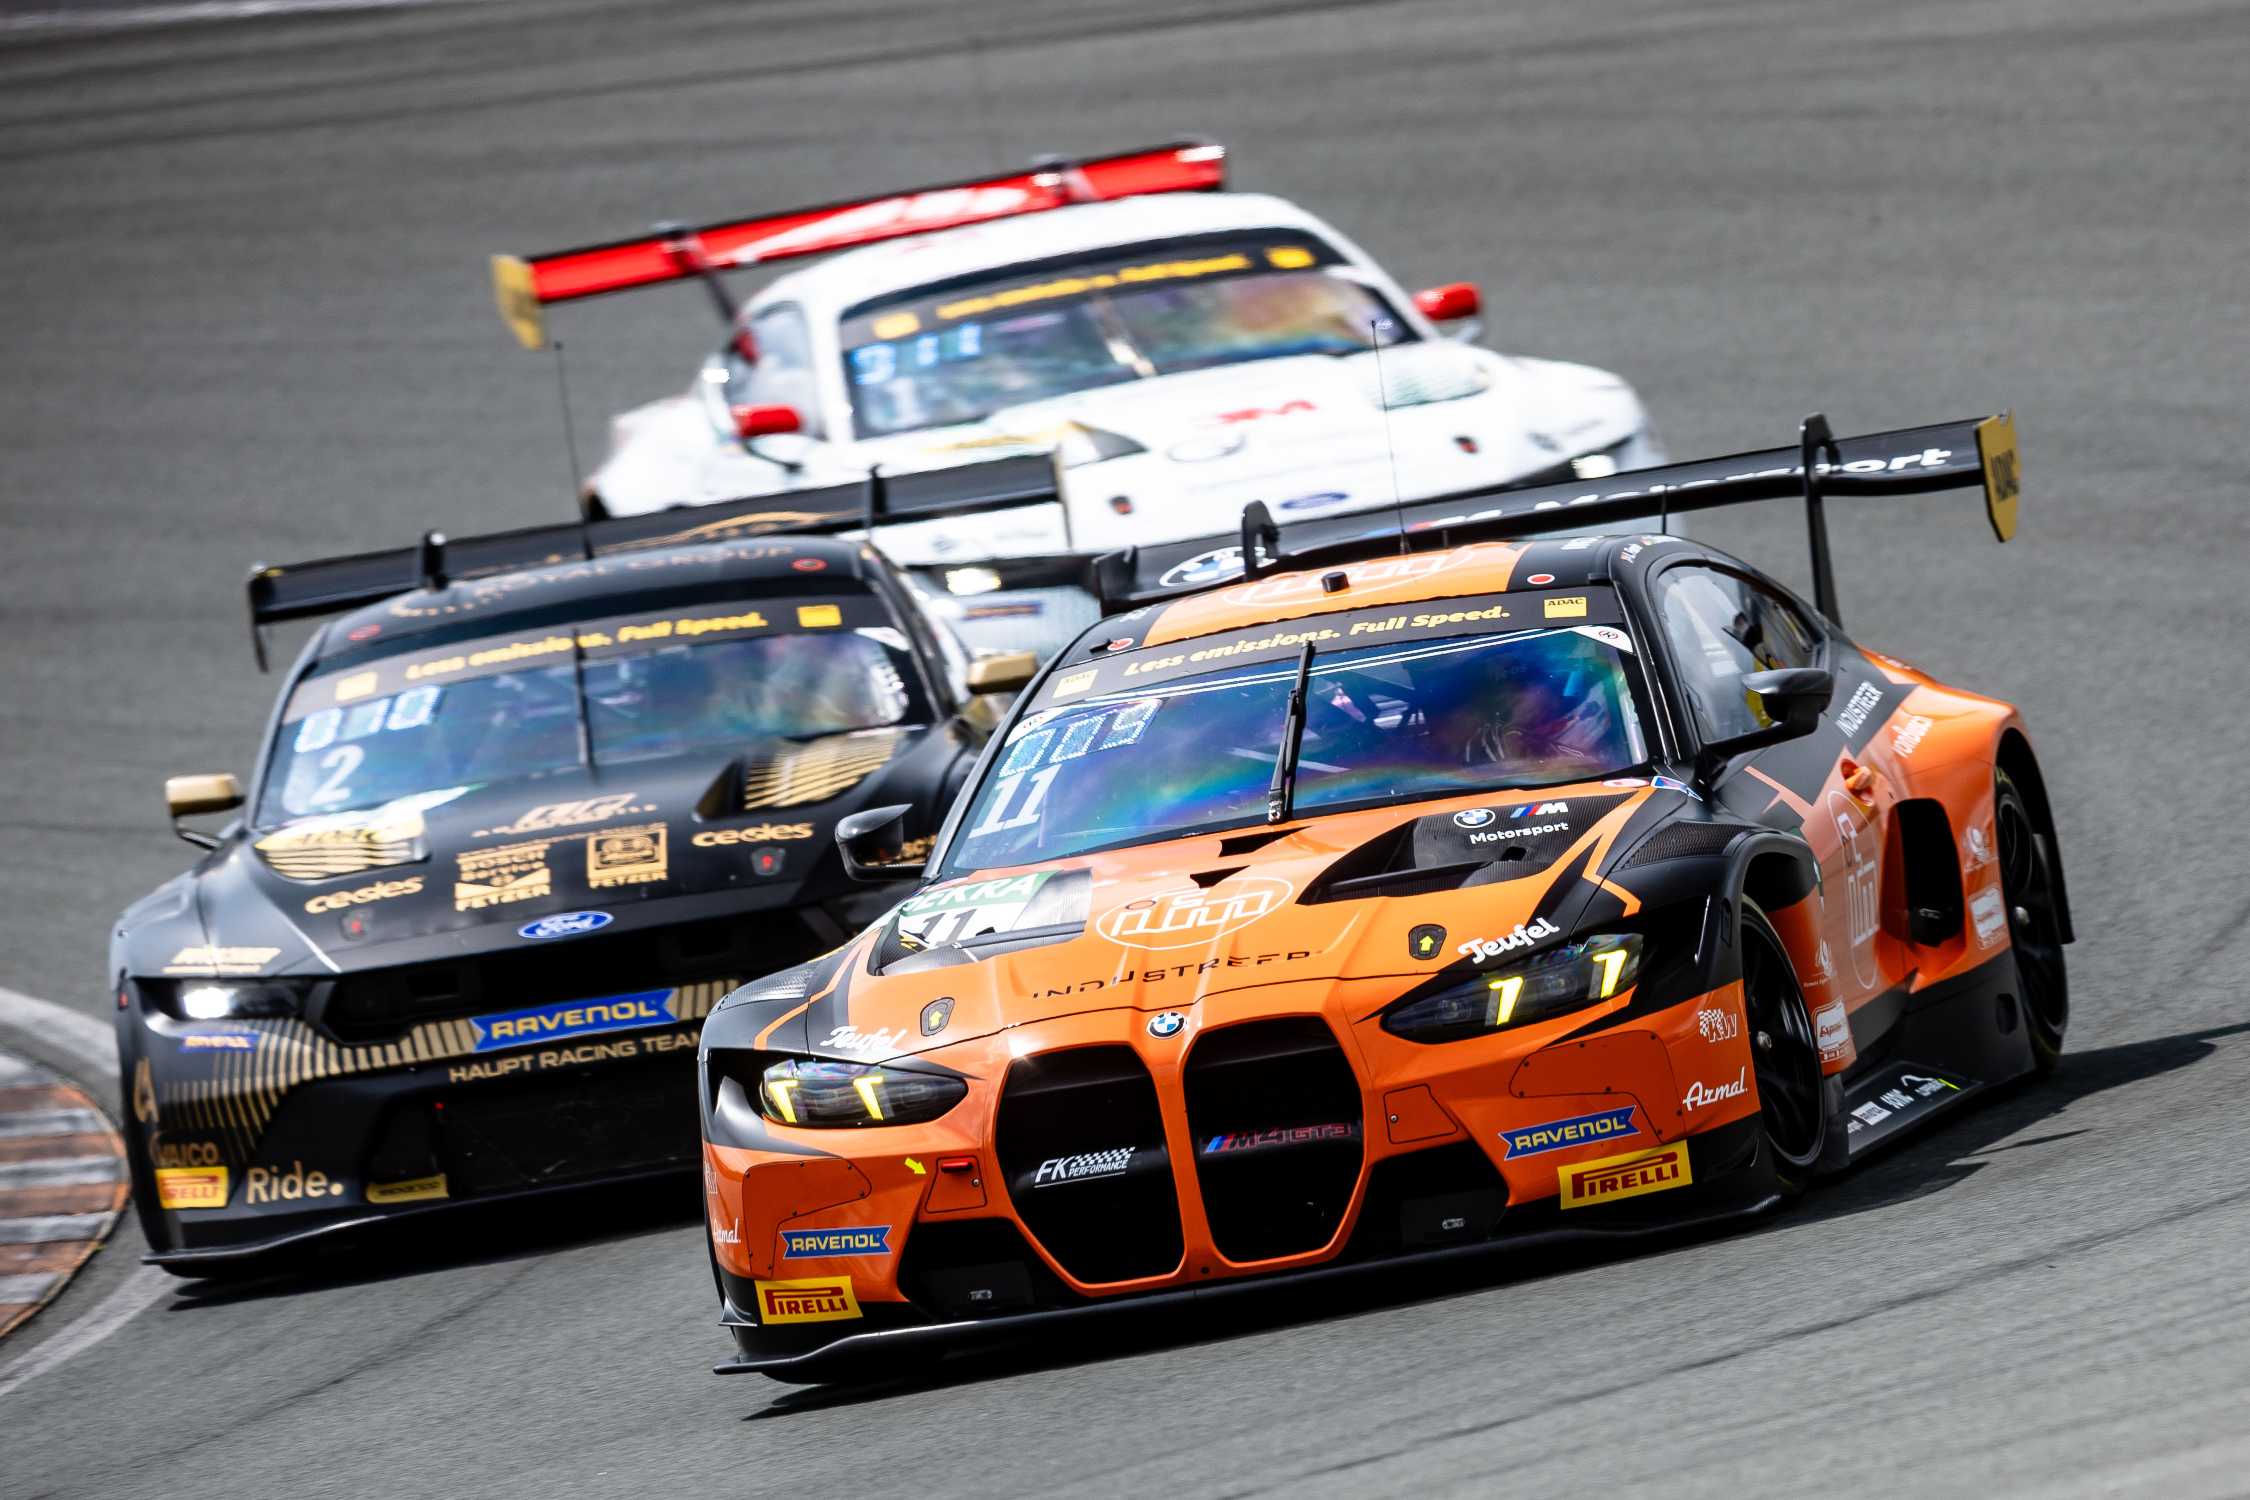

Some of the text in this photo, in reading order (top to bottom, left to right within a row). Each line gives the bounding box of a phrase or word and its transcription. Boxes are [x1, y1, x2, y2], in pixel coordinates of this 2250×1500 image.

[1123, 655, 1185, 676] Less
[1190, 627, 1341, 662] emissions.
[1349, 615, 1408, 637] Full
[1411, 604, 1511, 629] Speed.
[1834, 681, 1884, 739] INDUSTREER
[309, 743, 364, 806] 2
[967, 763, 1062, 839] 11
[1469, 821, 1570, 846] Motorsport
[1457, 917, 1560, 965] Teufel
[490, 1001, 660, 1040] RAVENOL
[819, 1025, 908, 1054] Teufel
[449, 1055, 533, 1084] HAUPT
[538, 1040, 637, 1069] RACING
[1514, 1116, 1627, 1150] RAVENOL
[246, 1160, 345, 1205] Ride.
[1034, 1156, 1128, 1183] FK PERFORMANCE
[1570, 1151, 1679, 1200] PIRELLI
[791, 1233, 880, 1252] RAVENOL
[764, 1286, 849, 1316] PIRELLI
